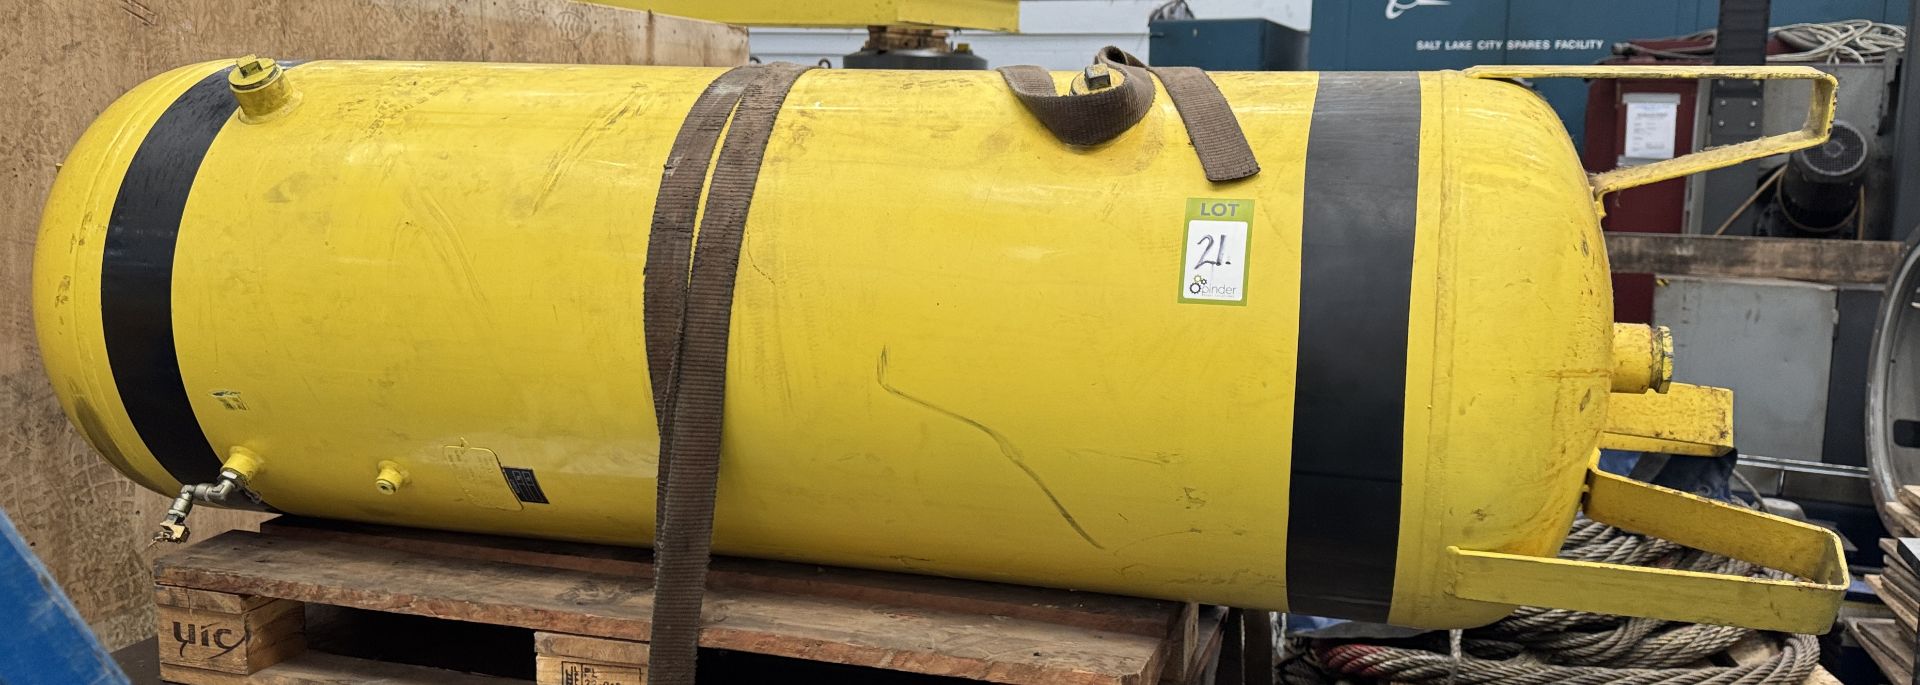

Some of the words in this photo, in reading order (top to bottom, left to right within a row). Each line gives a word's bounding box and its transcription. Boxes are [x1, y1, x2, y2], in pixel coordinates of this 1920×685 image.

[1416, 40, 1441, 51] SALT
[1445, 40, 1473, 51] LAKE
[1477, 40, 1503, 51] CITY
[1507, 40, 1551, 50] SPARES
[1554, 40, 1604, 50] FACILITY
[1200, 202, 1240, 217] LOT
[1201, 283, 1237, 297] pinder
